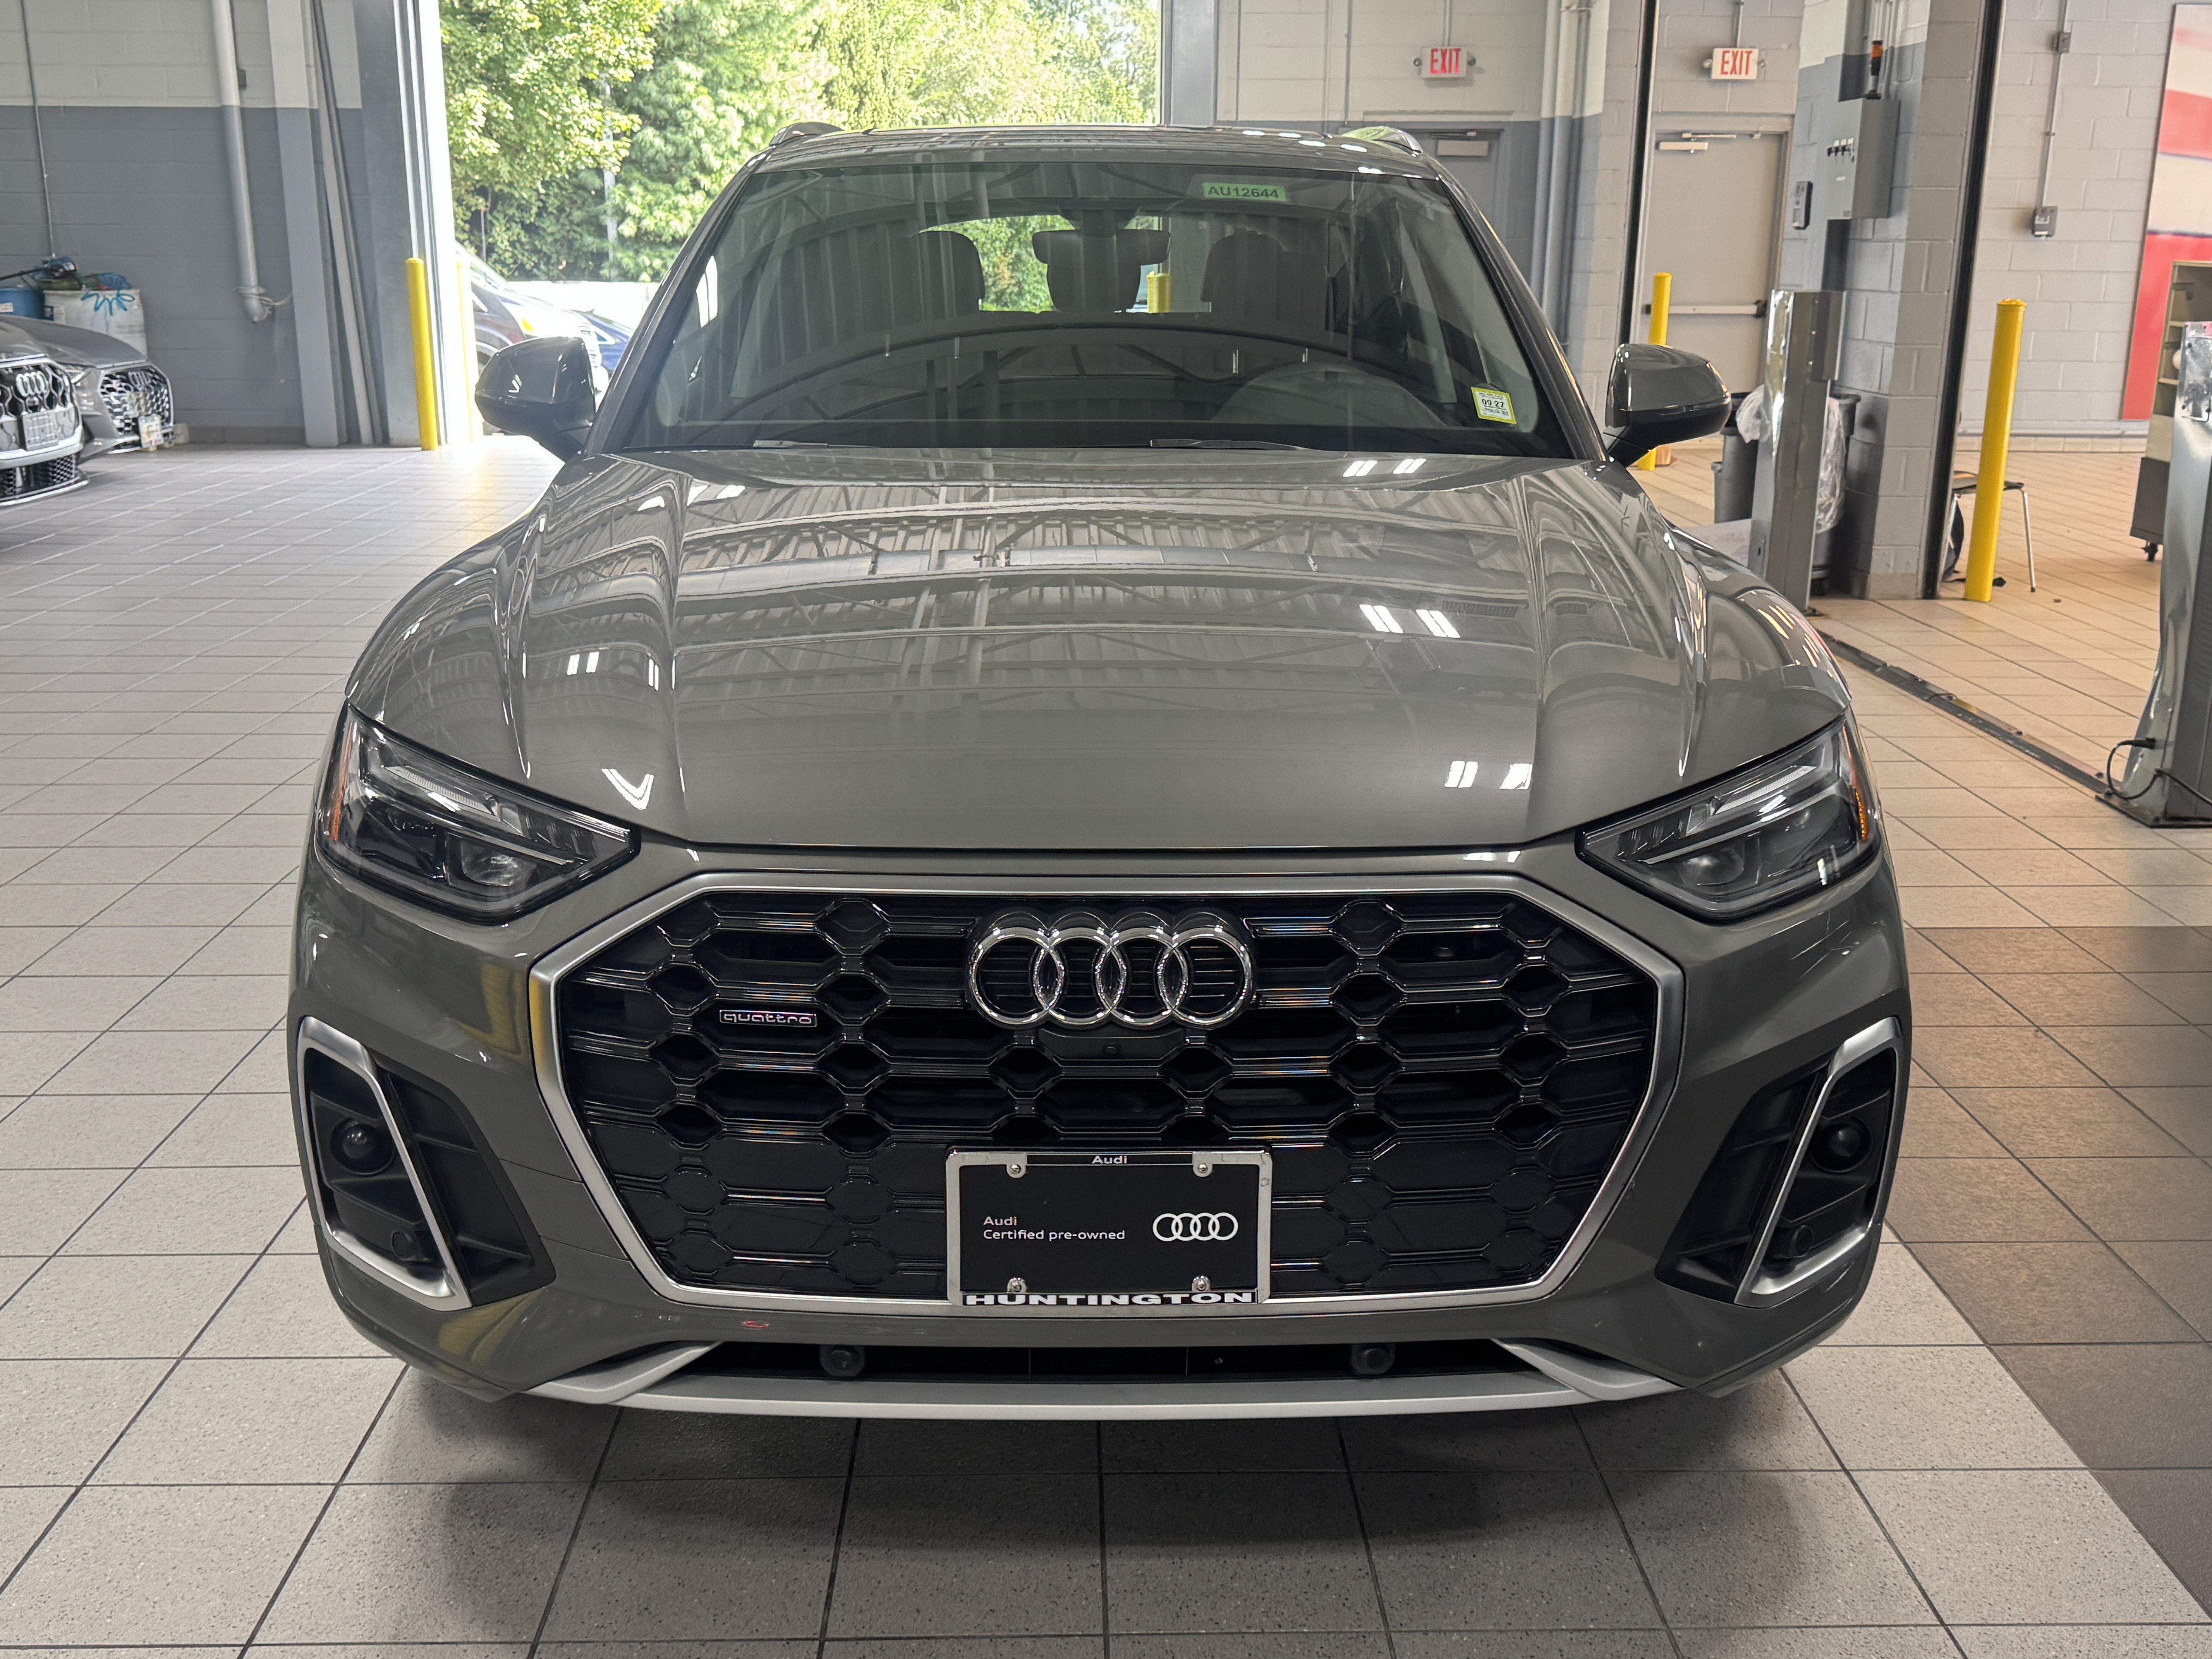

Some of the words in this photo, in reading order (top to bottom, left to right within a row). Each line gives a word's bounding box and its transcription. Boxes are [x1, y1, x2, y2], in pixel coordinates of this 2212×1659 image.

[1430, 48, 1461, 74] EXIT
[1721, 50, 1752, 75] EXIT
[1208, 186, 1279, 198] AU12644
[724, 1013, 812, 1024] quattro
[1092, 1156, 1127, 1164] Audi
[983, 1216, 1017, 1226] Audi
[983, 1230, 1044, 1239] Certified
[1049, 1230, 1125, 1242] pre-owned
[966, 1292, 1252, 1305] HUNTINGTON
